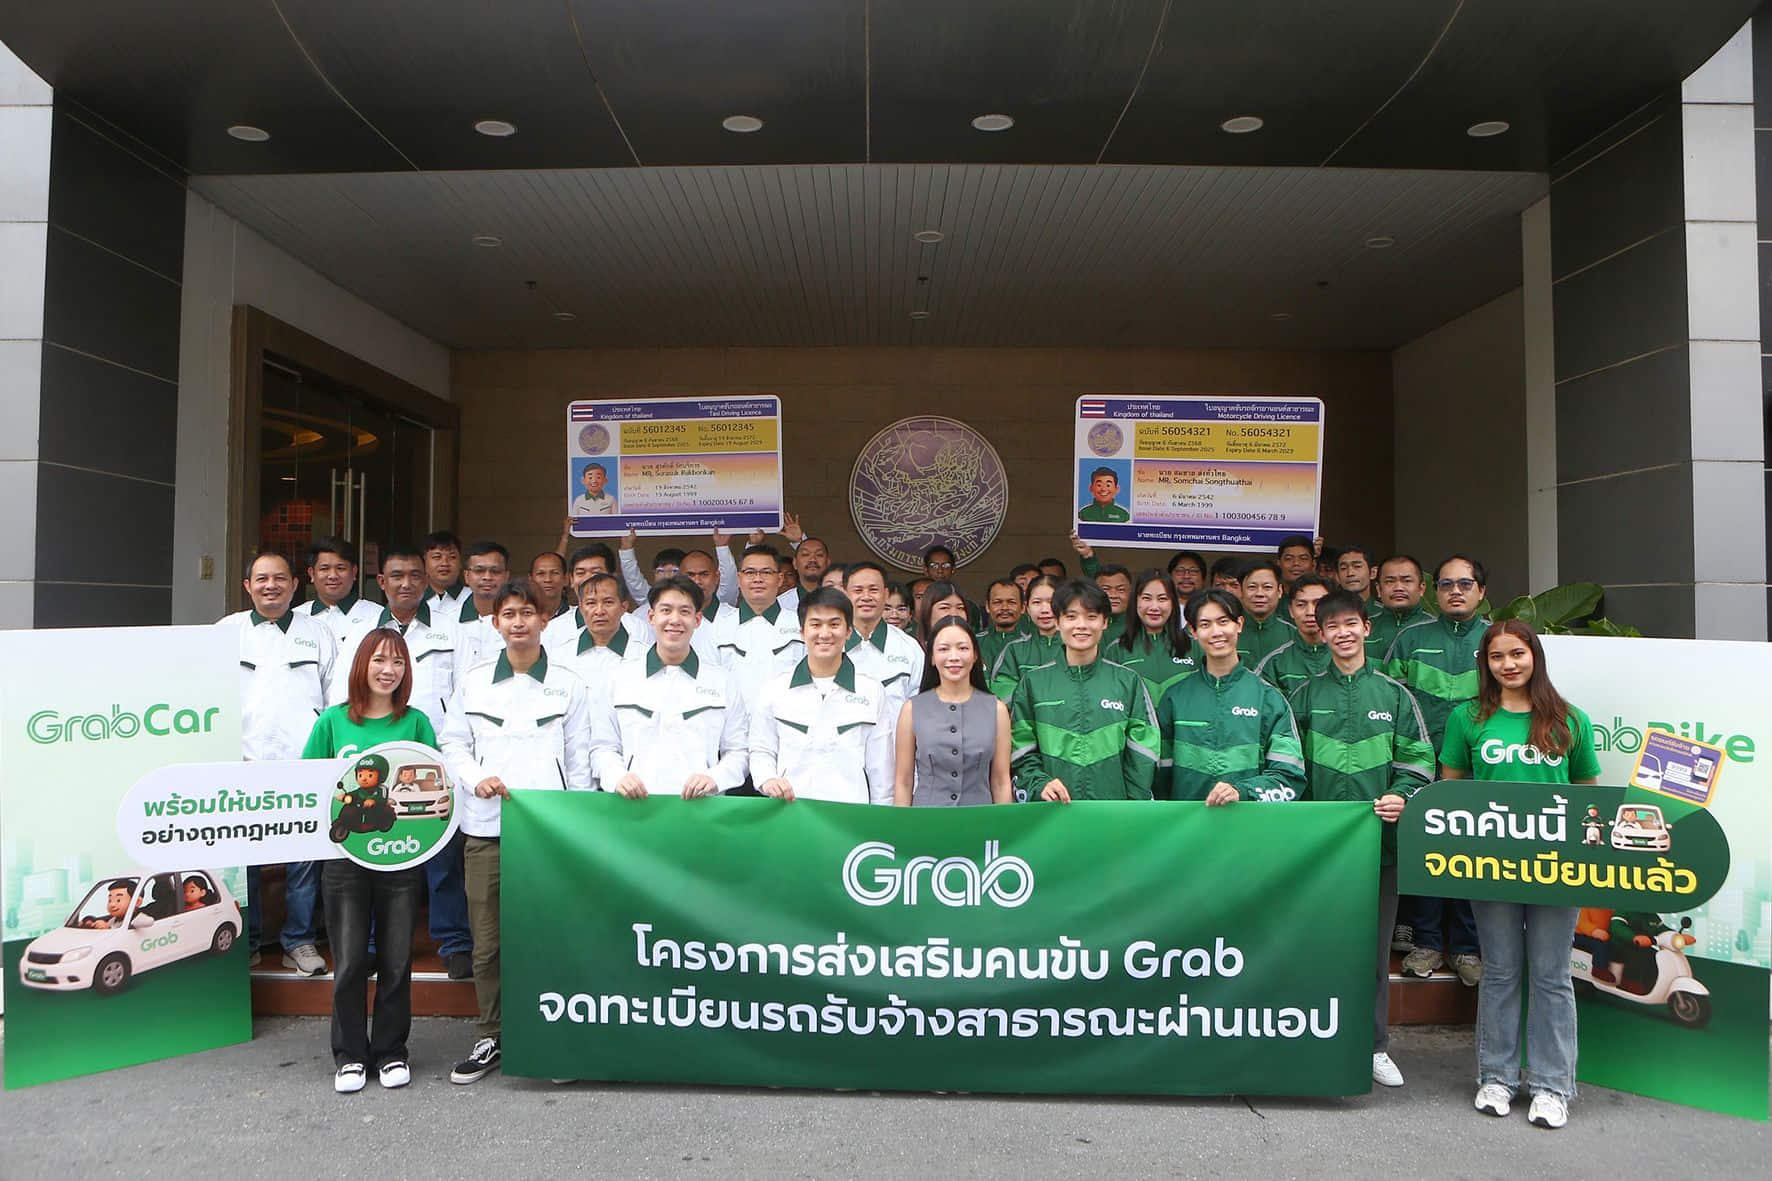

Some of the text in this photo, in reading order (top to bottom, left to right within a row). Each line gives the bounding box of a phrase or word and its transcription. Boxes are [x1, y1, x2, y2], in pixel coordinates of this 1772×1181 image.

[1127, 402, 1160, 410] ประเทศไทย
[1113, 411, 1140, 419] Kingdom
[643, 424, 686, 434] 56012345
[711, 423, 754, 432] 56012345
[1161, 426, 1211, 436] 56054321
[1226, 428, 1290, 437] No. 56054321
[1173, 477, 1204, 485] Somchai
[1204, 478, 1252, 487] Songthuathai
[699, 517, 725, 527] Bangkok
[1222, 512, 1266, 521] 100300456
[1222, 533, 1251, 542] Bangkok
[425, 632, 449, 641] Grab
[294, 637, 317, 649] Grab
[887, 654, 909, 665] Grab
[1172, 656, 1194, 666] Grab
[1101, 699, 1124, 711] Grab
[1231, 706, 1258, 717] Grab
[1367, 710, 1393, 722] Grab
[27, 703, 220, 744] GrabCar
[144, 789, 318, 817] พร้อมให้บริการ
[1424, 794, 1568, 842] รถคันนี้
[141, 819, 318, 847] อย่างถูกกฎหมาย
[367, 834, 420, 856] Grab
[842, 840, 1035, 908] Grab
[1424, 851, 1698, 895] จดทะเบียนแล้ว
[141, 931, 179, 951] Grab
[632, 922, 1244, 981] โครงการส่งเสริมคนขับ Grab
[1571, 960, 1588, 971] rab
[539, 985, 1339, 1039] จดทะเบียนรถรับจ้างสาธารณะผ่านแอป
